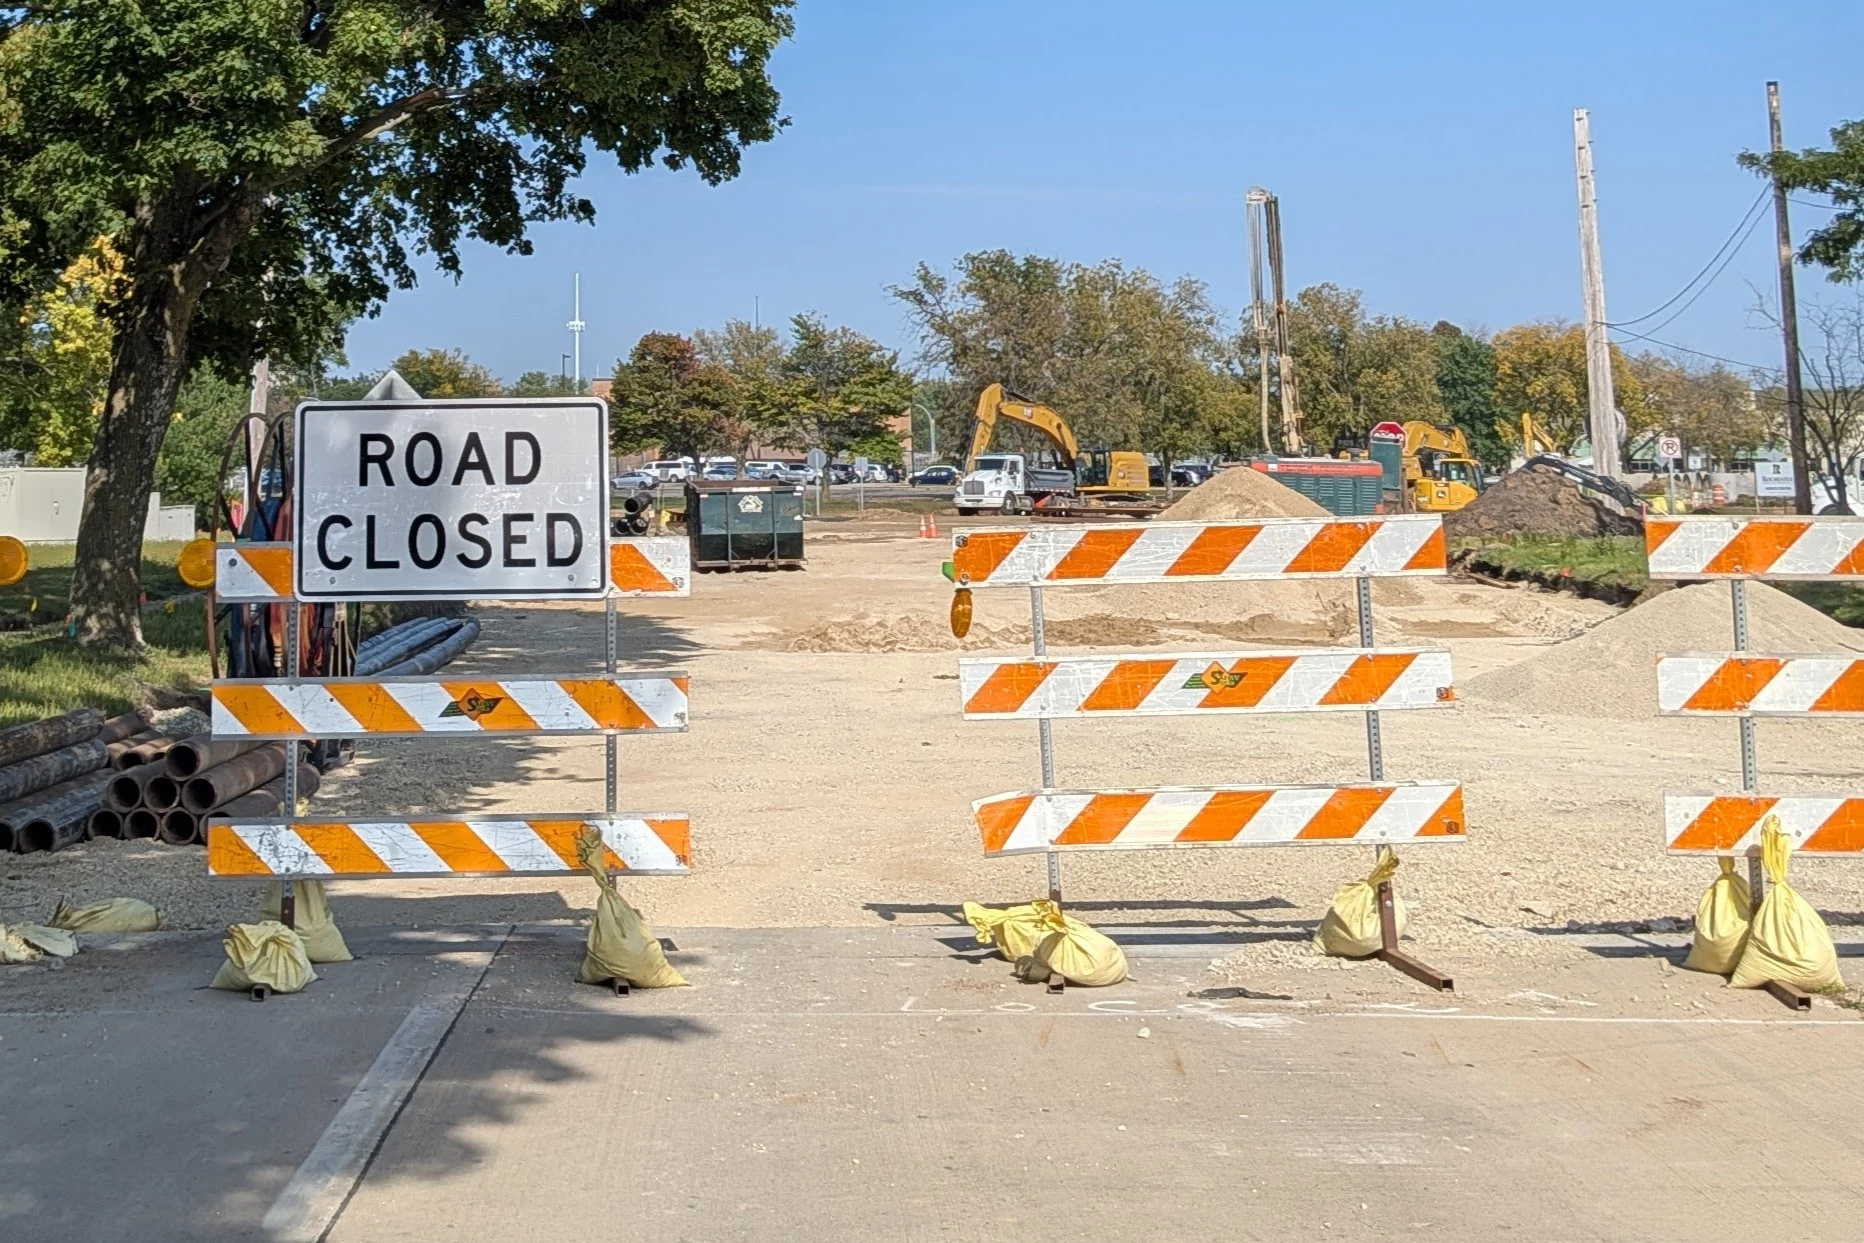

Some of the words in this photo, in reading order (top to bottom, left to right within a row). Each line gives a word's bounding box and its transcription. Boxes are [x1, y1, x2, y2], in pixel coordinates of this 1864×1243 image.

[359, 431, 542, 487] ROAD
[1772, 464, 1781, 474] R
[317, 512, 584, 571] CLOSED
